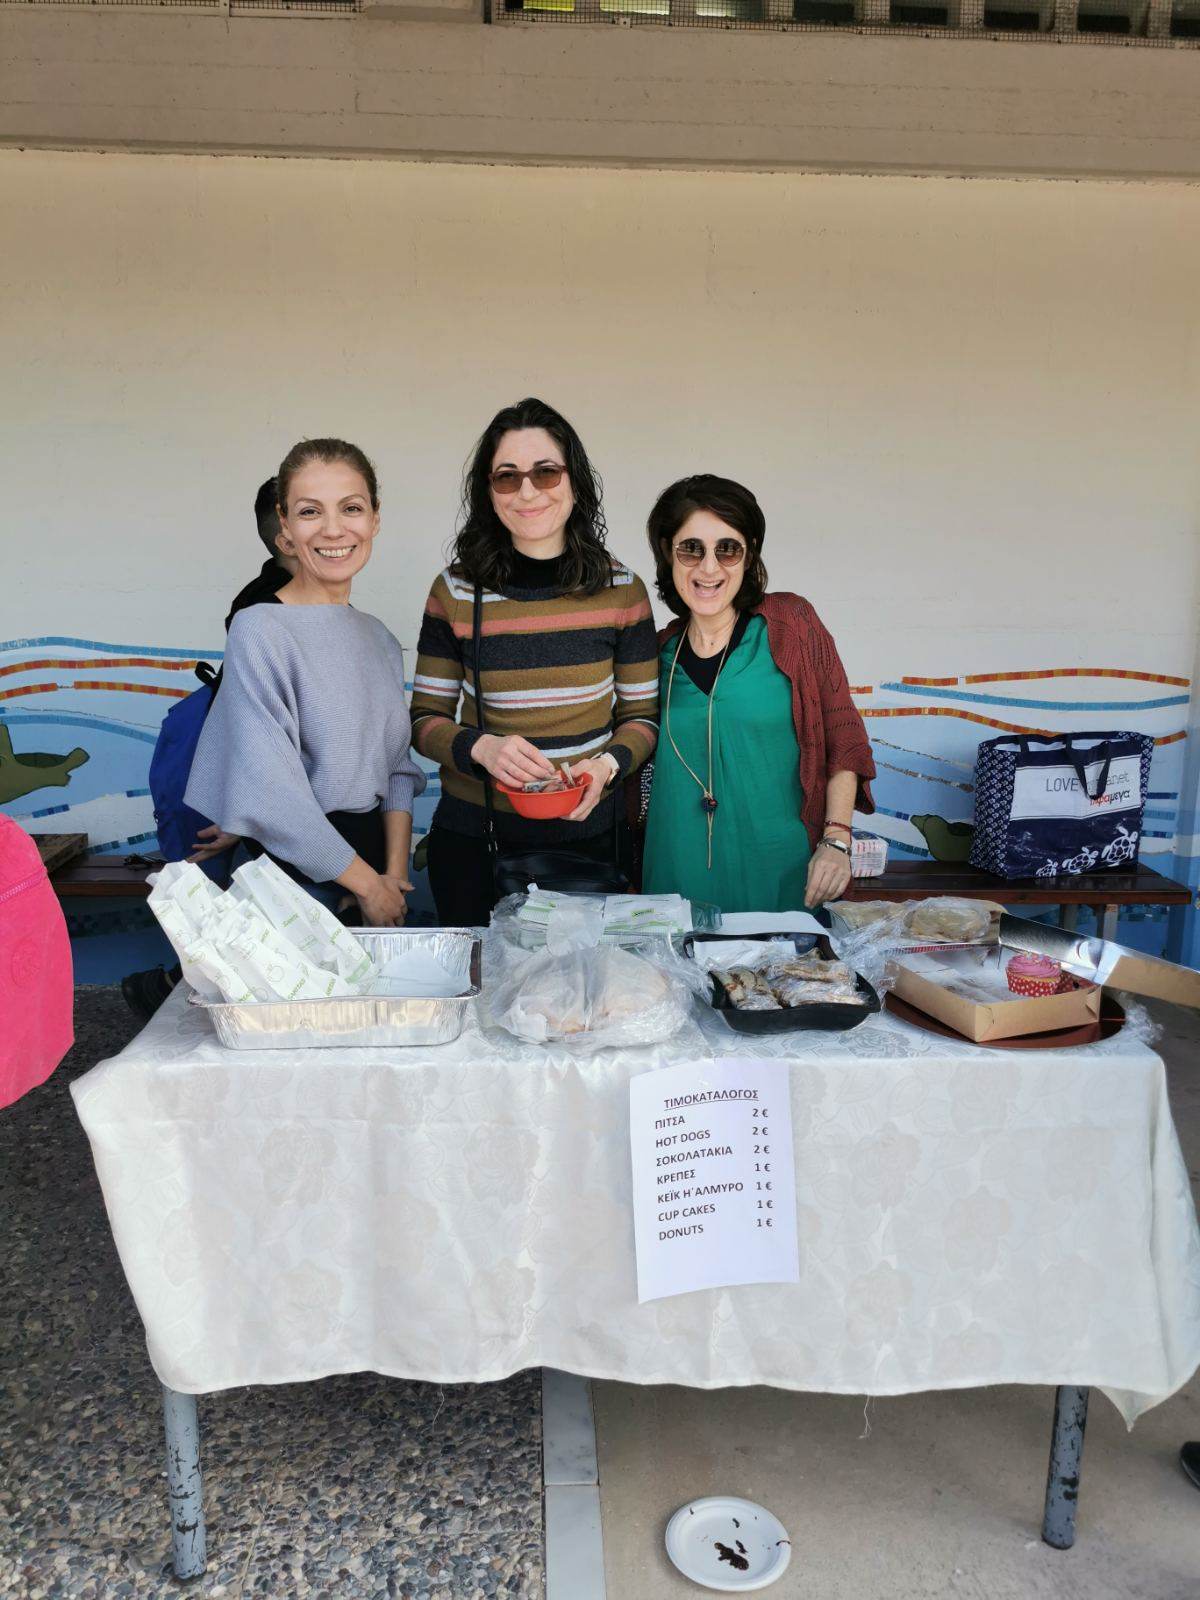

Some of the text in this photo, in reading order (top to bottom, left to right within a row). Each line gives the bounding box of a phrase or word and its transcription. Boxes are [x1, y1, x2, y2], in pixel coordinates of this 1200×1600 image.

[1045, 777, 1079, 792] LOVE
[664, 1089, 759, 1109] ΤΙΜΟΚΑΤΑΛΟΓΟΣ
[655, 1108, 769, 1129] ΠΙΤΣΑ 2 €
[655, 1126, 769, 1148] HOT DOGS 2 €
[656, 1144, 771, 1166] ΣΟΚΟΛΑΤΑΚΙΑ 2 €
[657, 1163, 771, 1184] ΚΡΕΠΕΣ 1 €
[756, 1181, 762, 1191] 1
[765, 1181, 773, 1191] €
[658, 1199, 774, 1222] CUP CAKES 1 €
[659, 1217, 773, 1240] DONUTS 1 €
